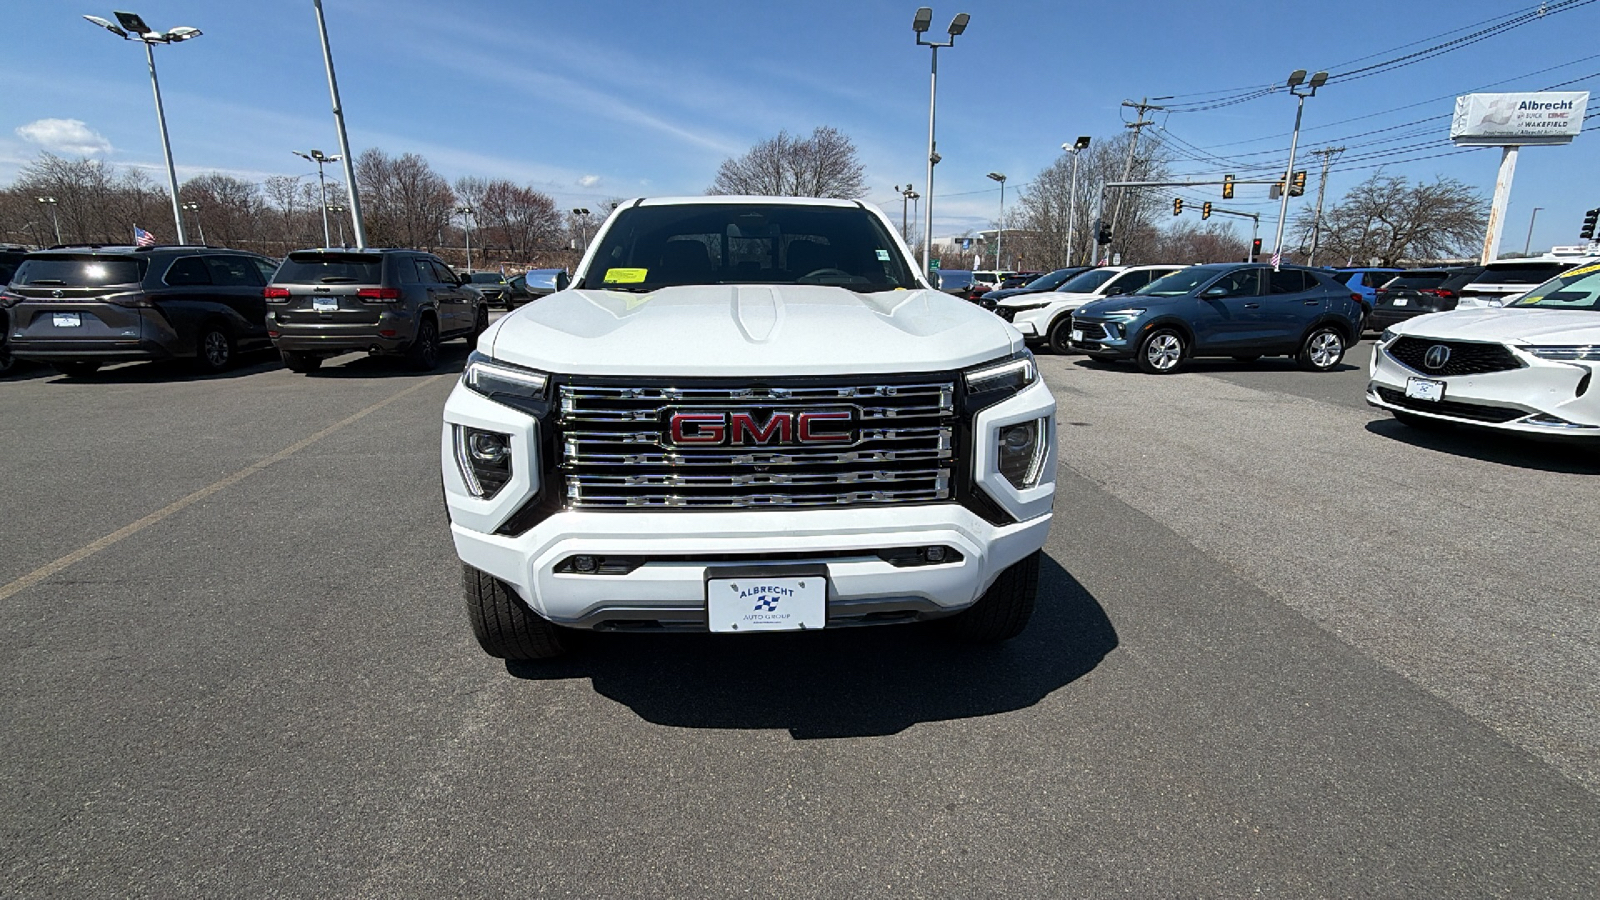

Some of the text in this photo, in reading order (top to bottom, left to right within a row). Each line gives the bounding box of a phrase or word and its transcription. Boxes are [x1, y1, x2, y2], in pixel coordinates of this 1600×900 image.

[1518, 100, 1573, 110] Albrecht
[670, 411, 851, 446] GMC
[740, 586, 794, 598] ALBRECHT
